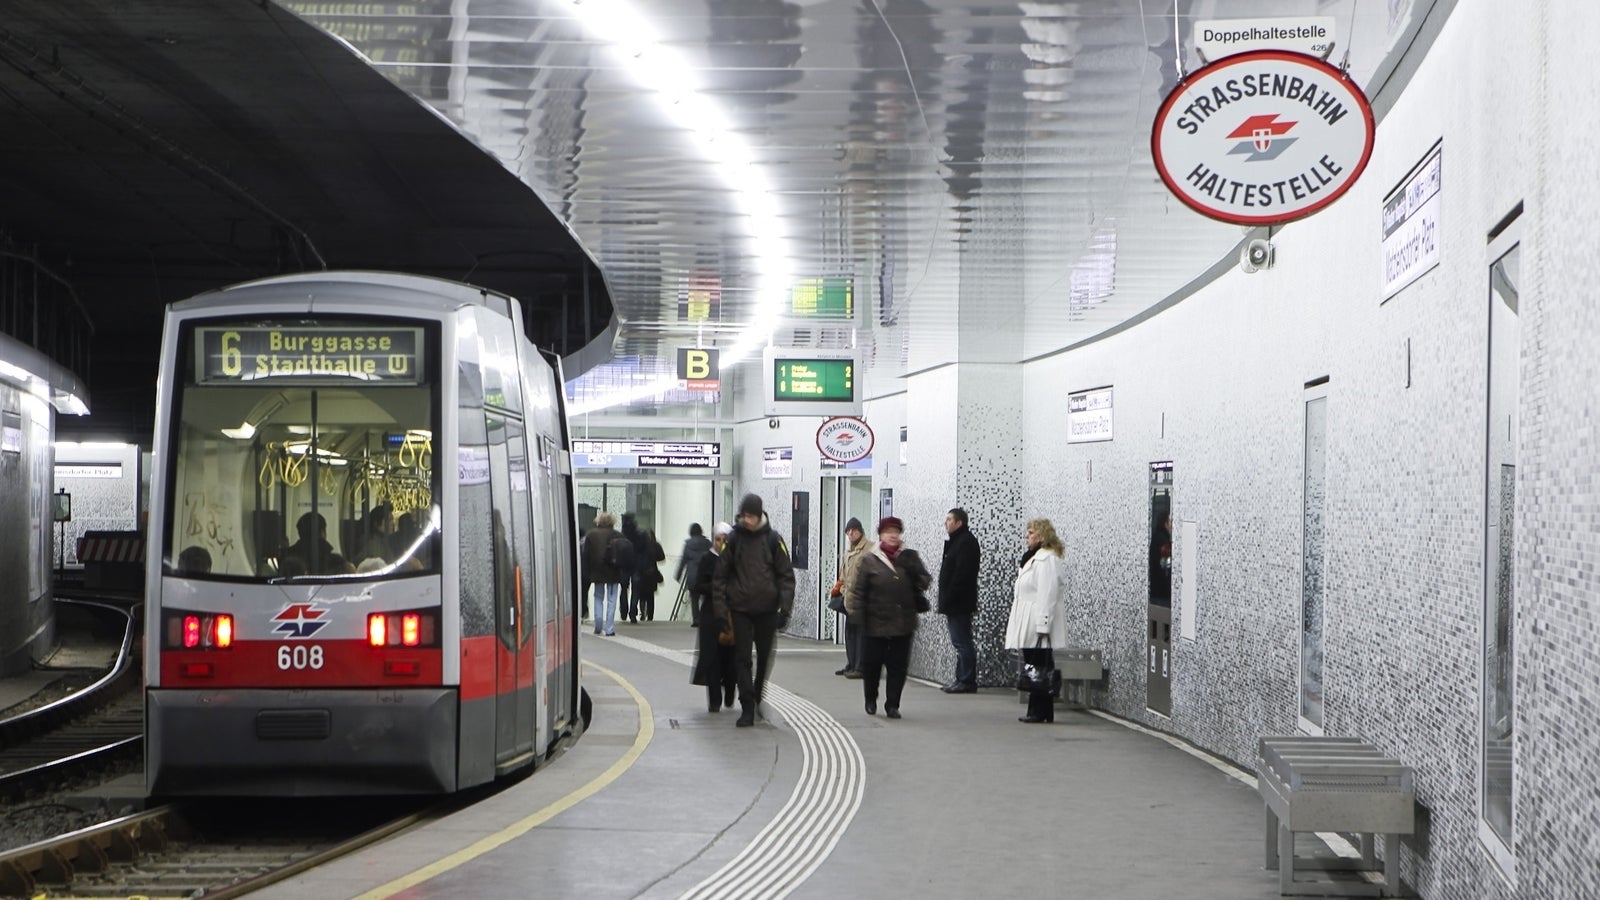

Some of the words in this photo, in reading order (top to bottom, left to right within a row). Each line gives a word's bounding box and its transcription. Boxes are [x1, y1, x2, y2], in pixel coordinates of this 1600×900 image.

[1203, 25, 1327, 44] Doppelhaltestelle
[1310, 44, 1327, 52] 426
[1176, 73, 1349, 135] STRASSENBAHN
[1186, 154, 1343, 207] HALTESTELLE
[270, 332, 391, 352] Burggasse
[221, 331, 242, 376] 6
[256, 354, 376, 374] Stadthalle
[686, 350, 710, 379] B
[845, 366, 852, 378] 2
[822, 421, 868, 439] STRASSENBAHN
[824, 444, 866, 459] HALTESTELLE
[277, 645, 324, 670] 608
